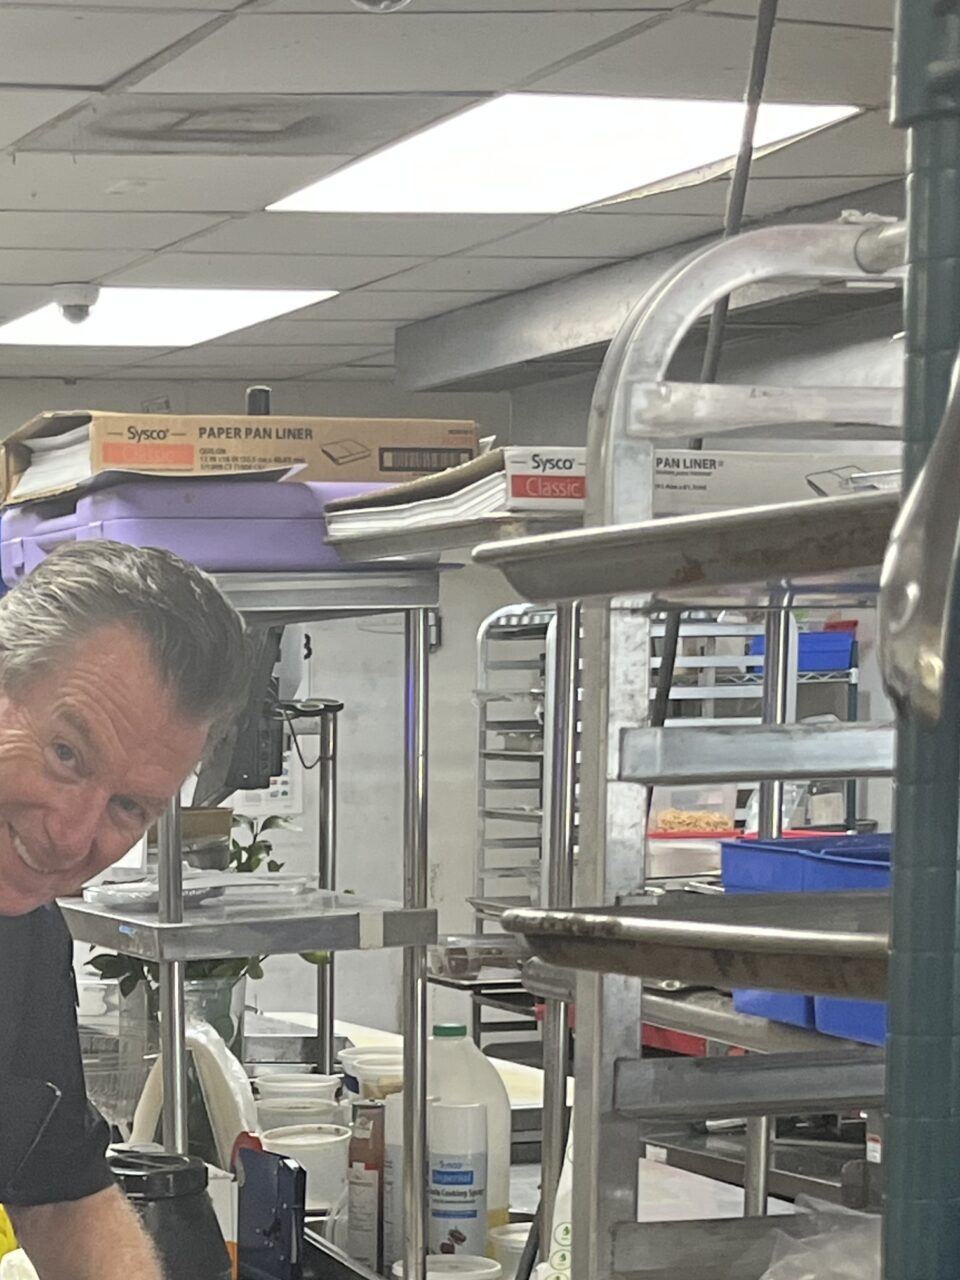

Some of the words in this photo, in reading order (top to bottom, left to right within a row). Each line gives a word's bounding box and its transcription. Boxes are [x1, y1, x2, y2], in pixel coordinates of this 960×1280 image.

[127, 425, 167, 443] Sysco
[198, 427, 242, 439] PAPER
[244, 427, 272, 440] PAN
[275, 428, 313, 440] LINER
[532, 454, 573, 472] Sysco
[656, 458, 680, 469] PAN
[683, 458, 716, 470] LINER
[526, 477, 582, 497] Classic
